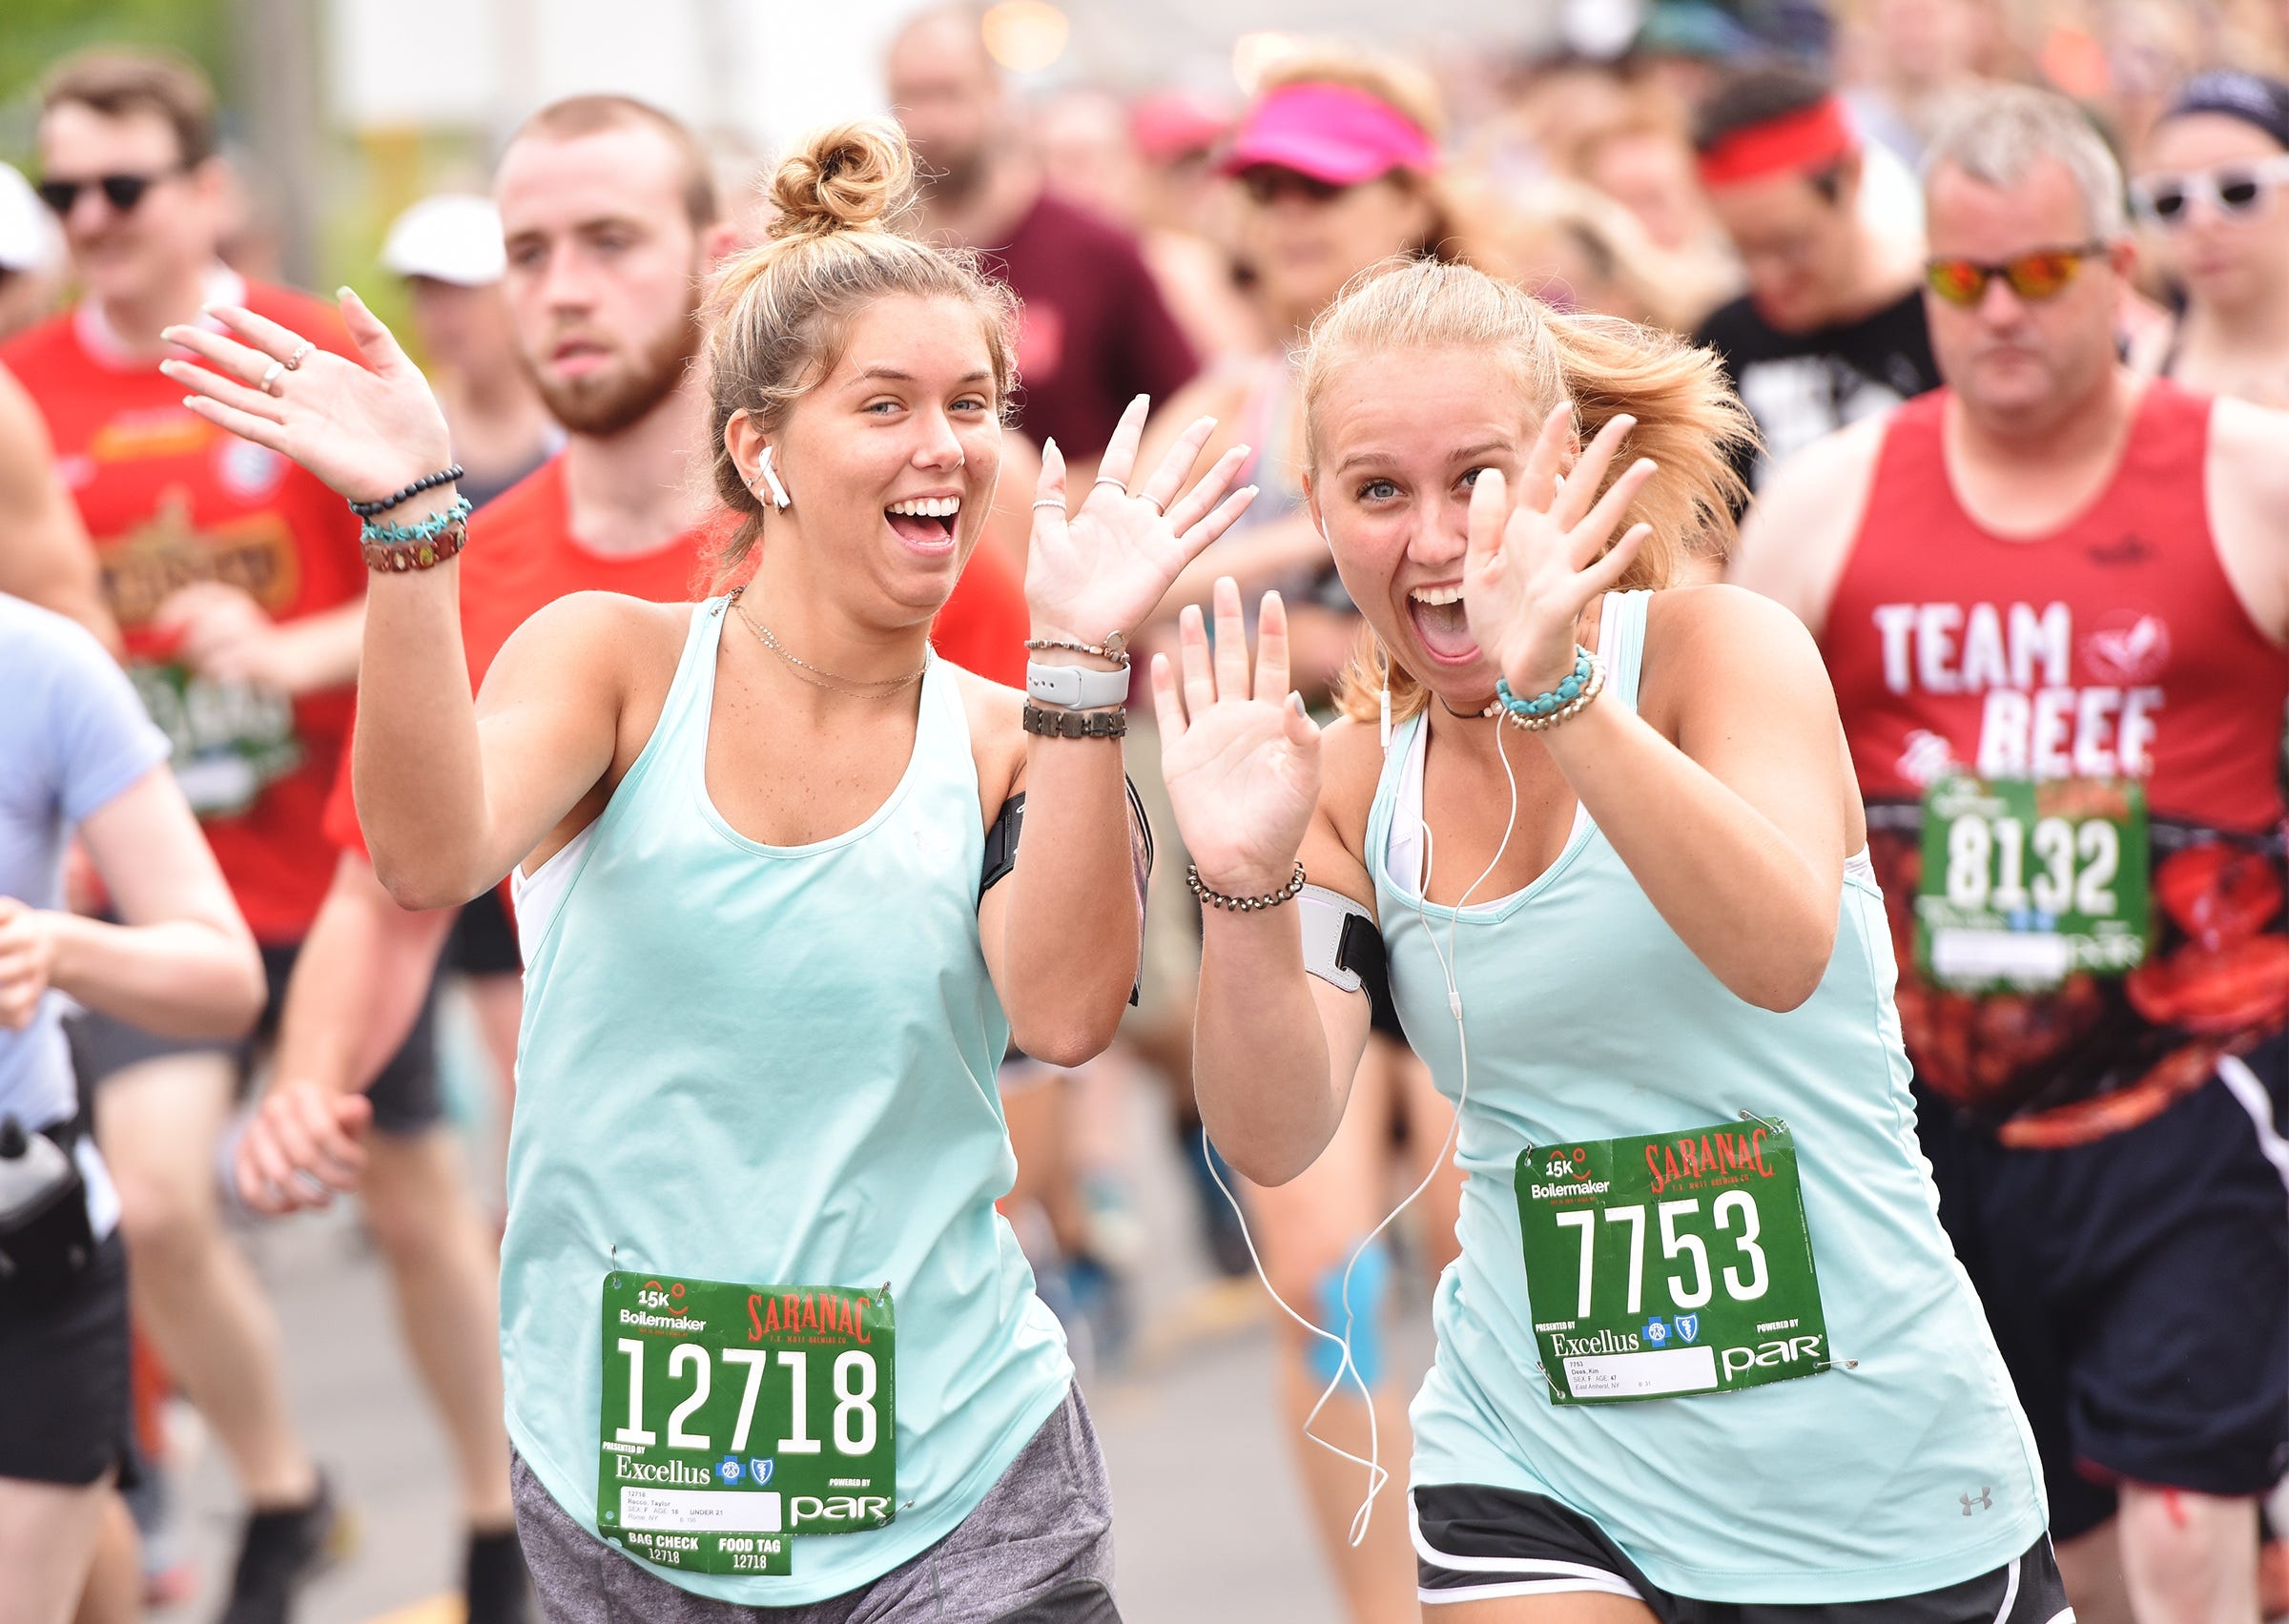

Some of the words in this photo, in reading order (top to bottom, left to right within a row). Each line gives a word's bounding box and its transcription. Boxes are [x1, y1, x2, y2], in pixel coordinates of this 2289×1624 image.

[1873, 602, 2072, 695] TEAM
[1978, 686, 2164, 778] BEEF
[1947, 814, 2120, 915] 8132
[1546, 1161, 1573, 1178] 15K
[1645, 1128, 1774, 1194] SARANAC
[1531, 1180, 1610, 1199] Boilermaker
[1556, 1189, 1769, 1319] 7753
[638, 1290, 670, 1307] 15K
[620, 1308, 707, 1331] Boilermaker
[748, 1292, 871, 1344] SARANAC
[1535, 1322, 1567, 1332] PRESENTED
[1566, 1321, 1575, 1329] BY
[1757, 1321, 1788, 1333] POWERED
[1789, 1319, 1799, 1327] BY
[1550, 1329, 1639, 1357] Excellus
[616, 1338, 877, 1455] 12718
[602, 1441, 635, 1453] PRESENTED
[636, 1446, 645, 1454] BY
[615, 1454, 711, 1484] Excellus
[829, 1478, 860, 1487] POWERED
[861, 1478, 871, 1487] BY
[629, 1531, 652, 1546] BAG
[656, 1535, 699, 1550] CHECK
[718, 1538, 753, 1552] FOOD
[757, 1538, 780, 1552] TAG
[649, 1549, 680, 1564] 12718
[733, 1554, 767, 1569] 12718
